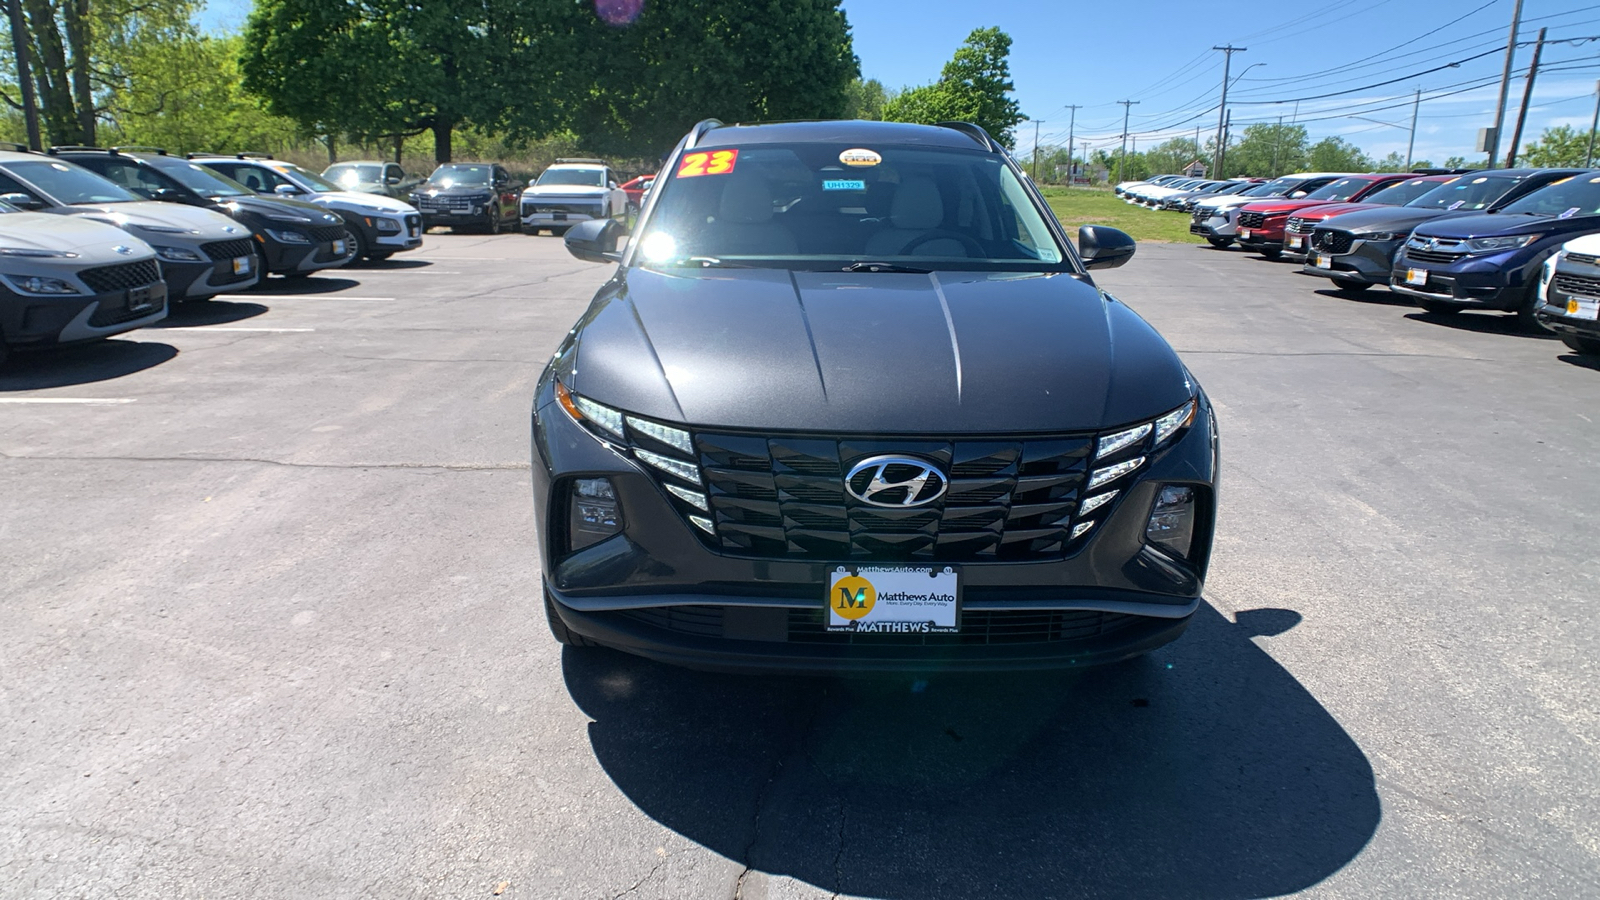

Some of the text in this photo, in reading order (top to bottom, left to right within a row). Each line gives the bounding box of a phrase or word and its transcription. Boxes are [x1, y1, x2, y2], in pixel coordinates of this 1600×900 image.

[678, 150, 734, 177] 23
[827, 181, 861, 189] UH1329
[856, 566, 933, 574] MatthewsAuto.com
[837, 587, 868, 609] M
[877, 591, 955, 602] Matthews Auto
[856, 622, 930, 633] MATTHEWS
